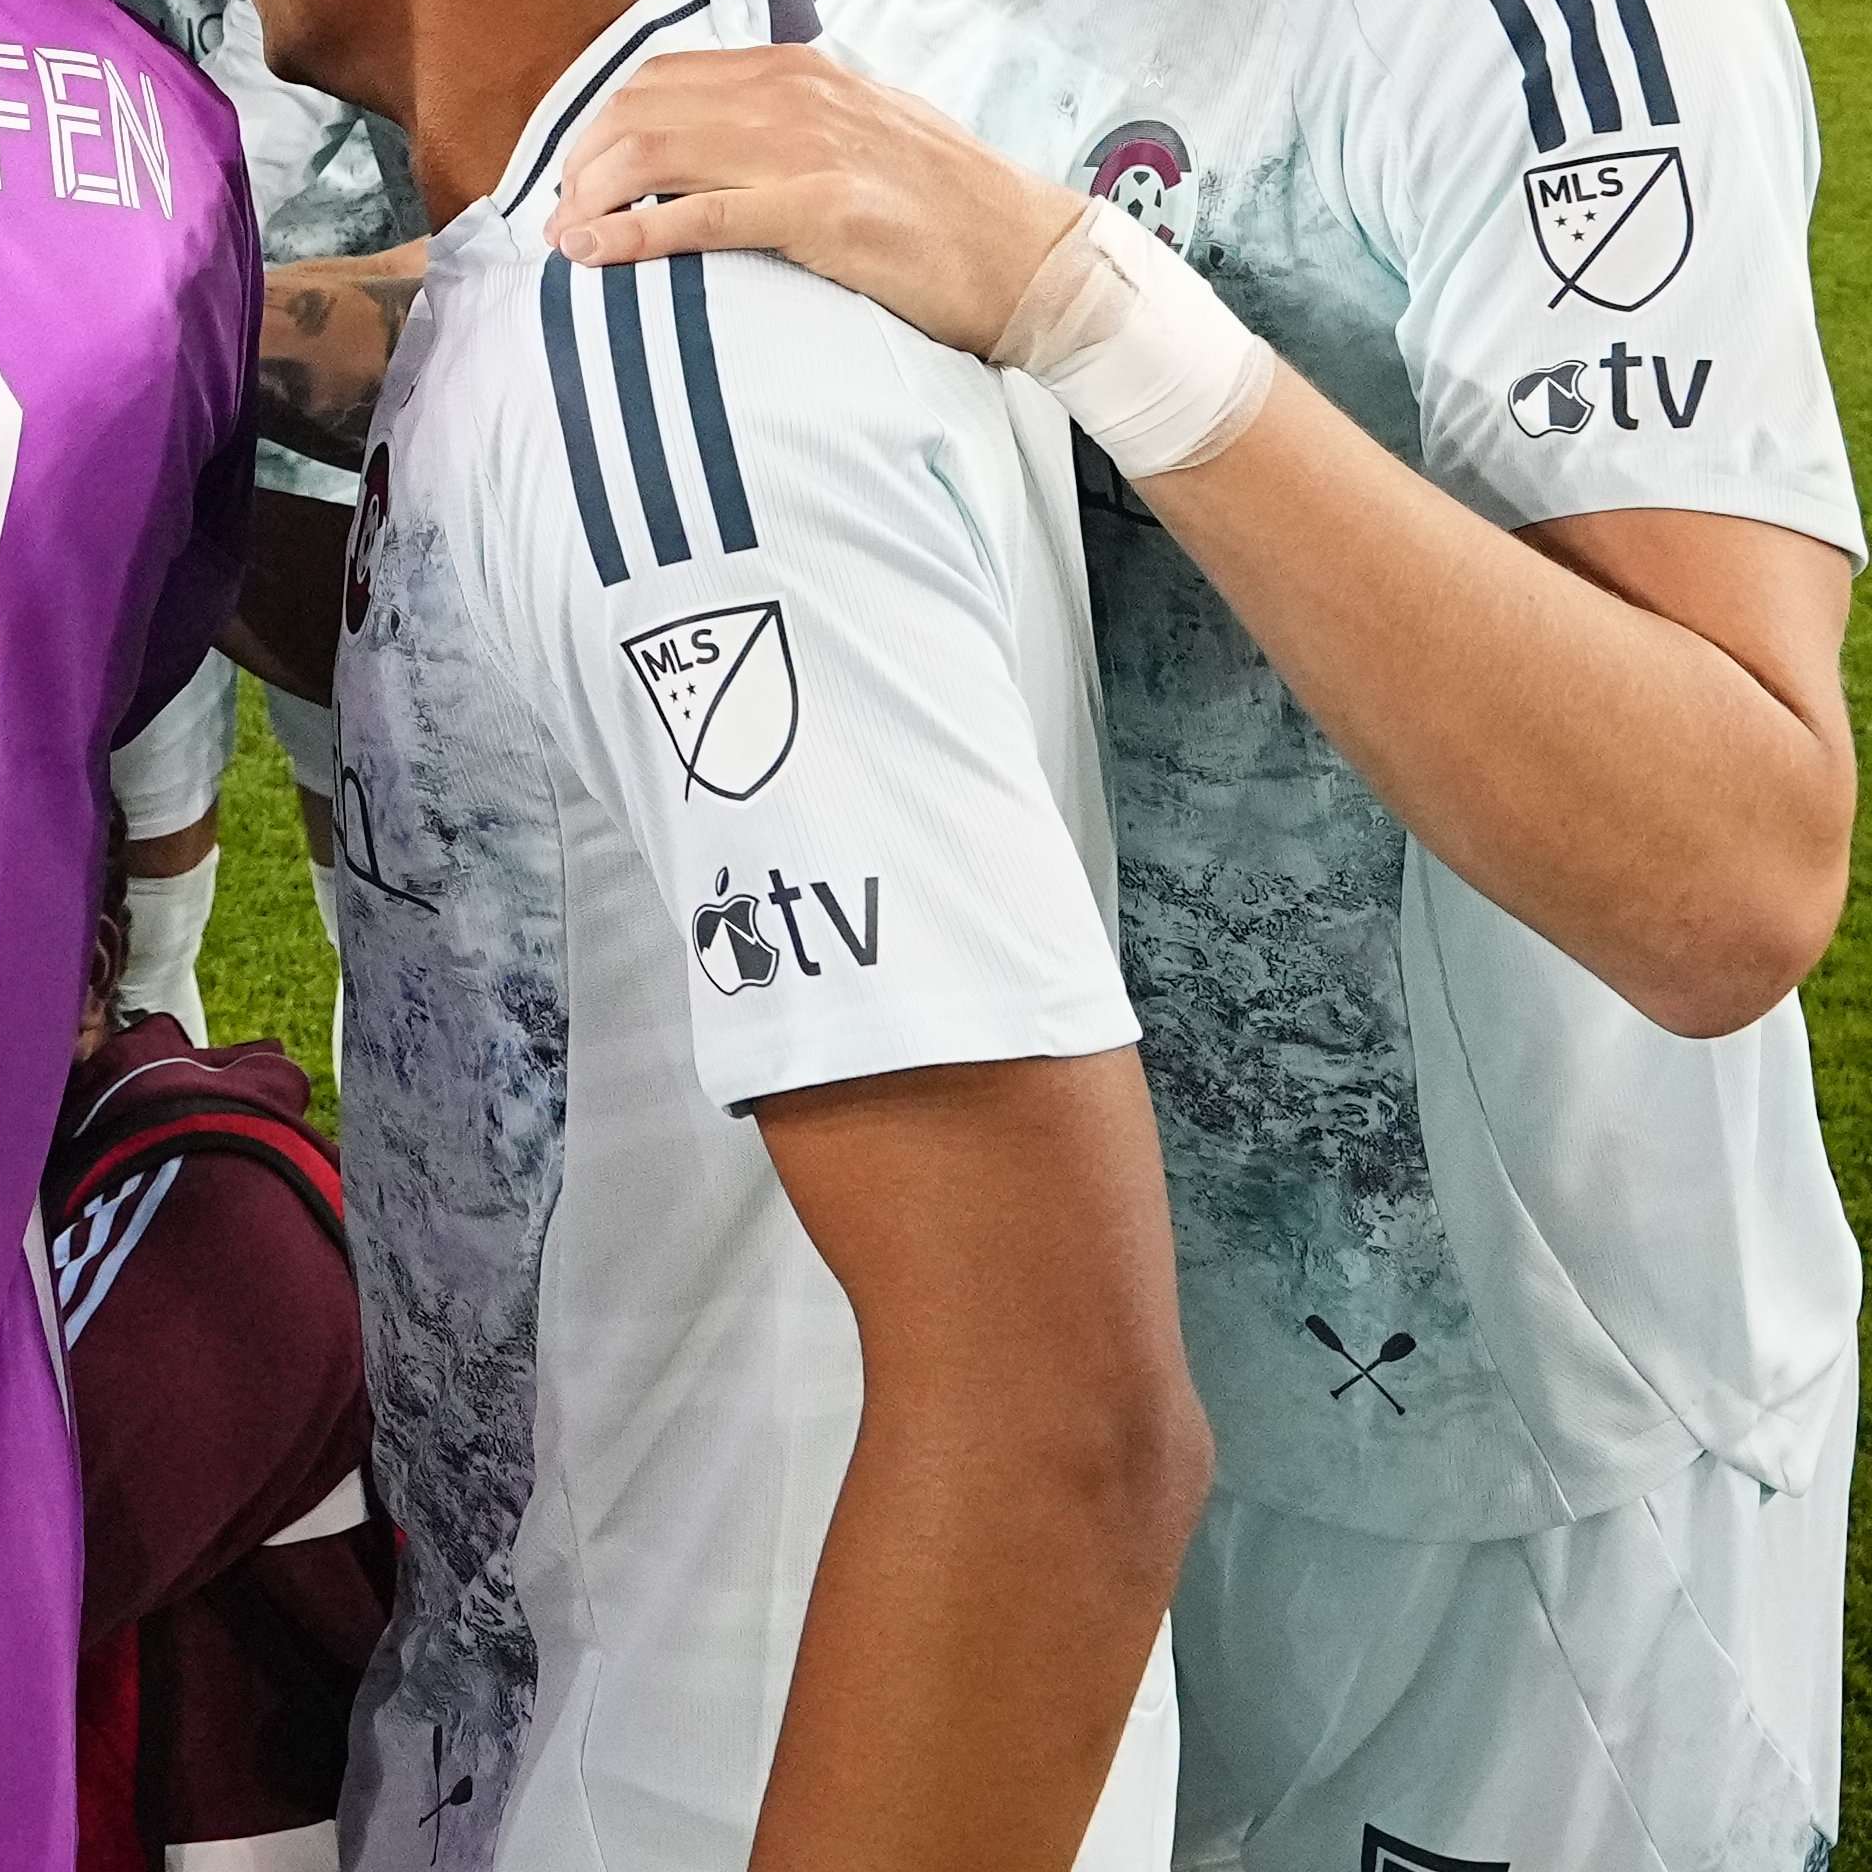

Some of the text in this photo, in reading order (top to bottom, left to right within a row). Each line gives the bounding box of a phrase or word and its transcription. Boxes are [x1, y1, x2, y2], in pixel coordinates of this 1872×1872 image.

[1538, 167, 1624, 208] MLS
[1599, 341, 1713, 431] tv
[641, 629, 720, 682] MLS
[768, 869, 880, 978] tv
